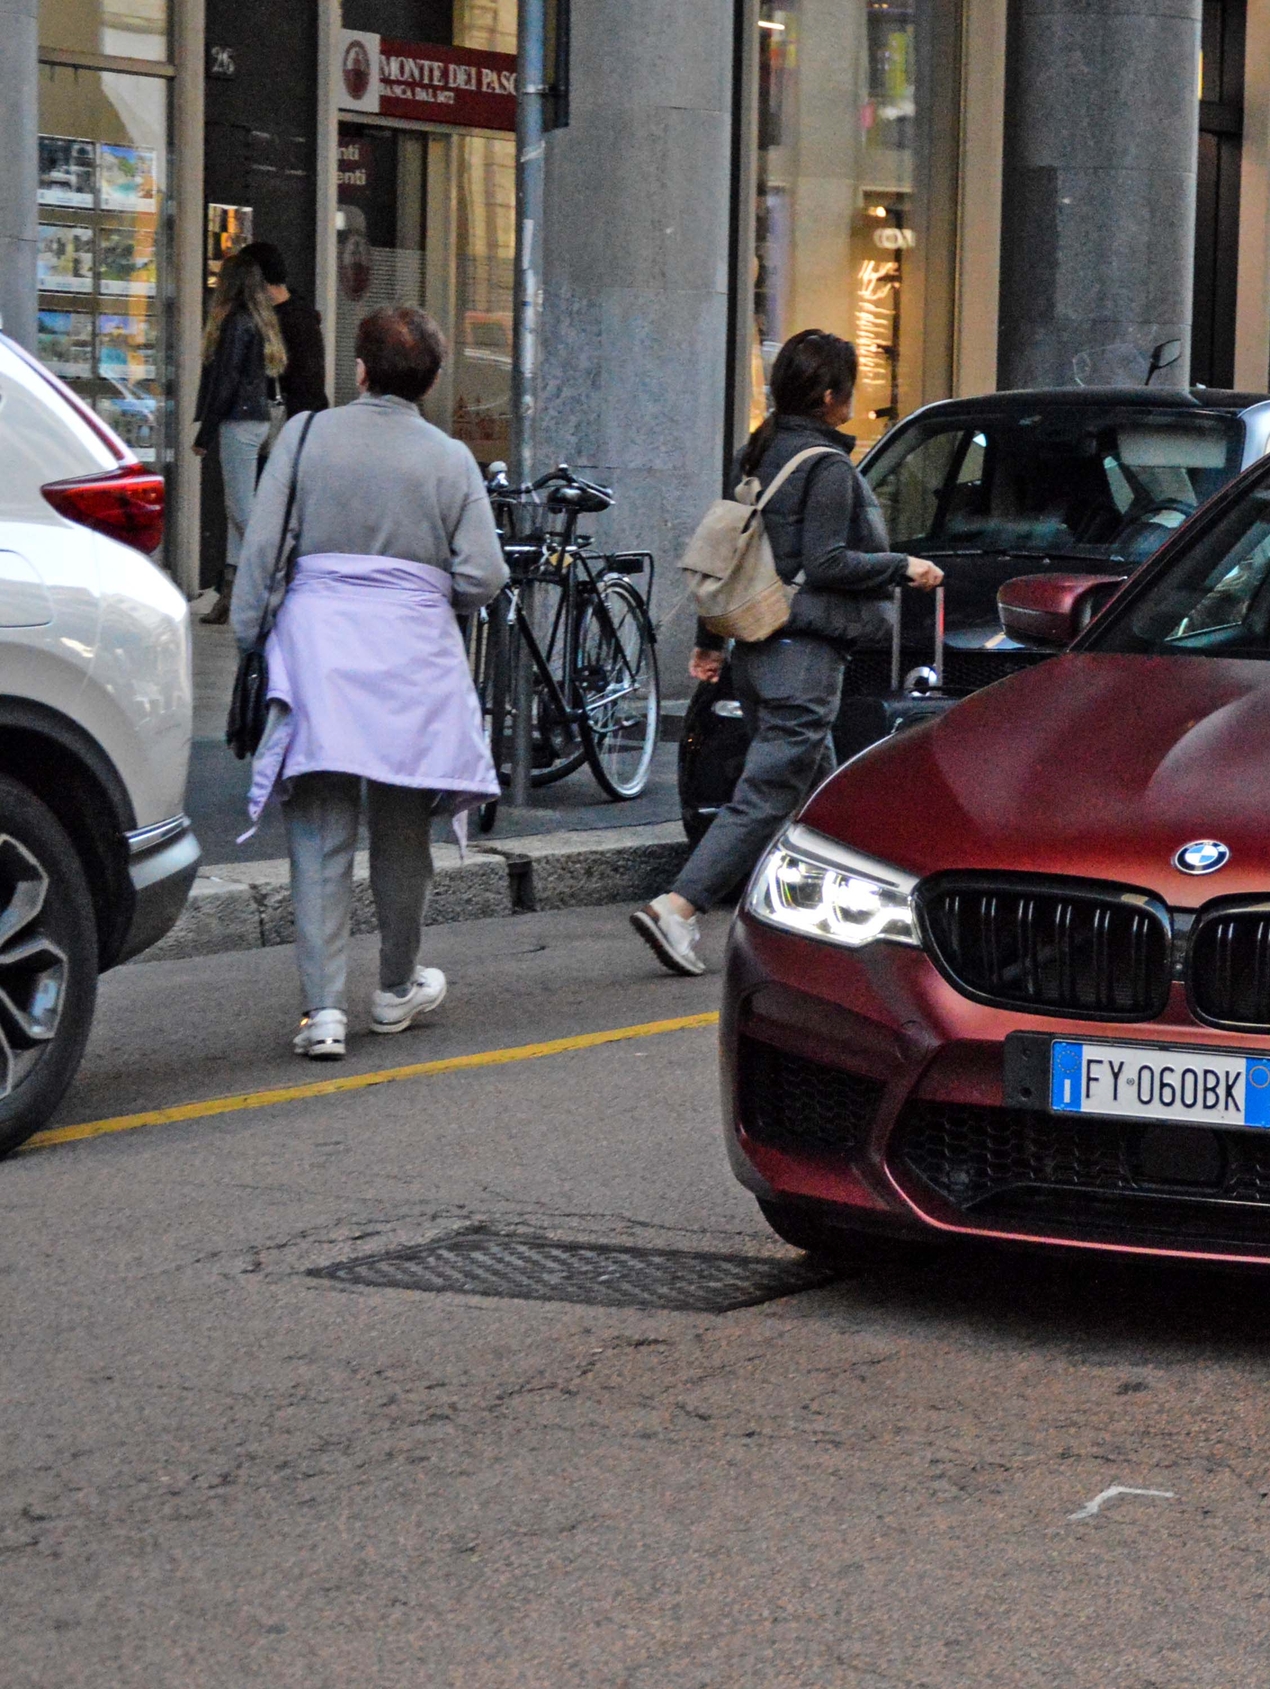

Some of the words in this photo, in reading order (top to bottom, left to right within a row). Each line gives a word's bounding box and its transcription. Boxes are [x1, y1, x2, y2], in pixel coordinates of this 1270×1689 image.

[211, 46, 235, 75] 26
[379, 54, 444, 86] MONTE
[448, 63, 477, 90] DEI
